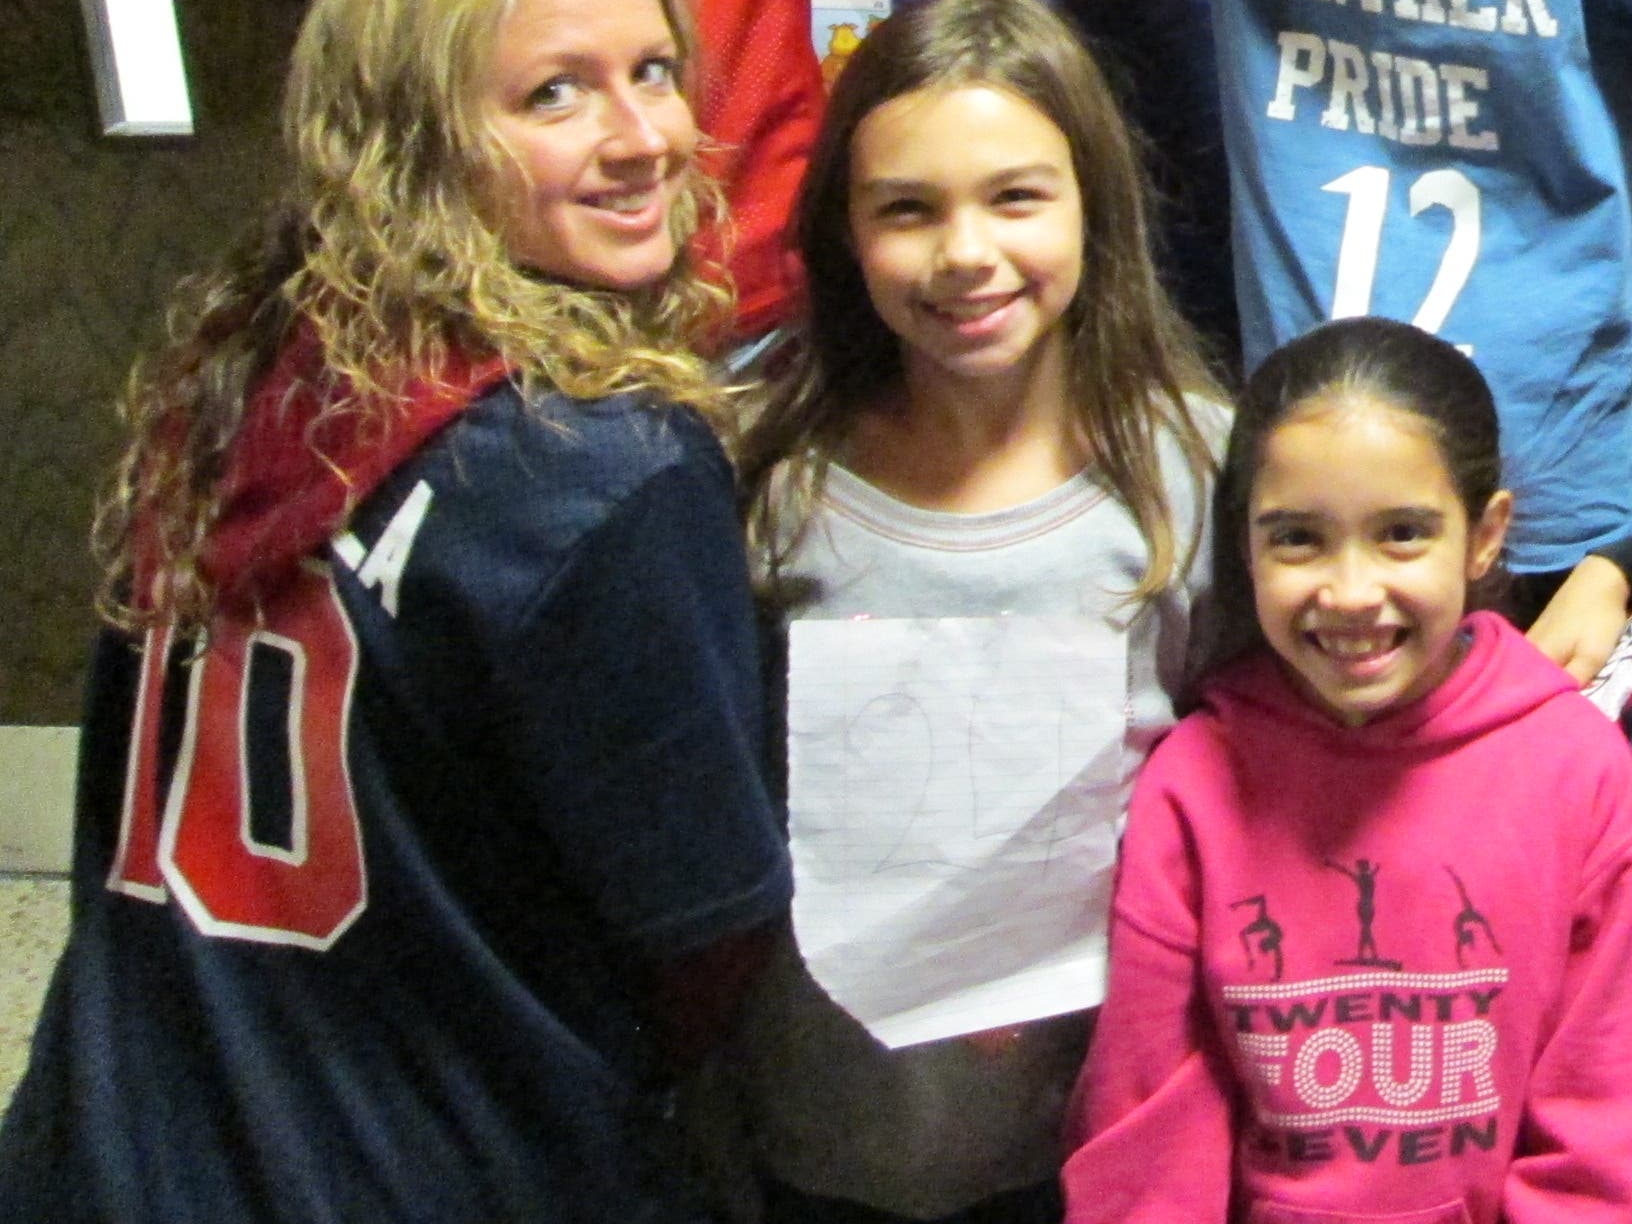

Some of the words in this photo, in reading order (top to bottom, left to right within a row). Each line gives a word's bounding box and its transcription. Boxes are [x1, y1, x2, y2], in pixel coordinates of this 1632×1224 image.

[1265, 31, 1499, 152] PRIDE
[1319, 165, 1482, 356] 12
[1226, 987, 1501, 1033] TWENTY
[1236, 1018, 1499, 1109] FOUR
